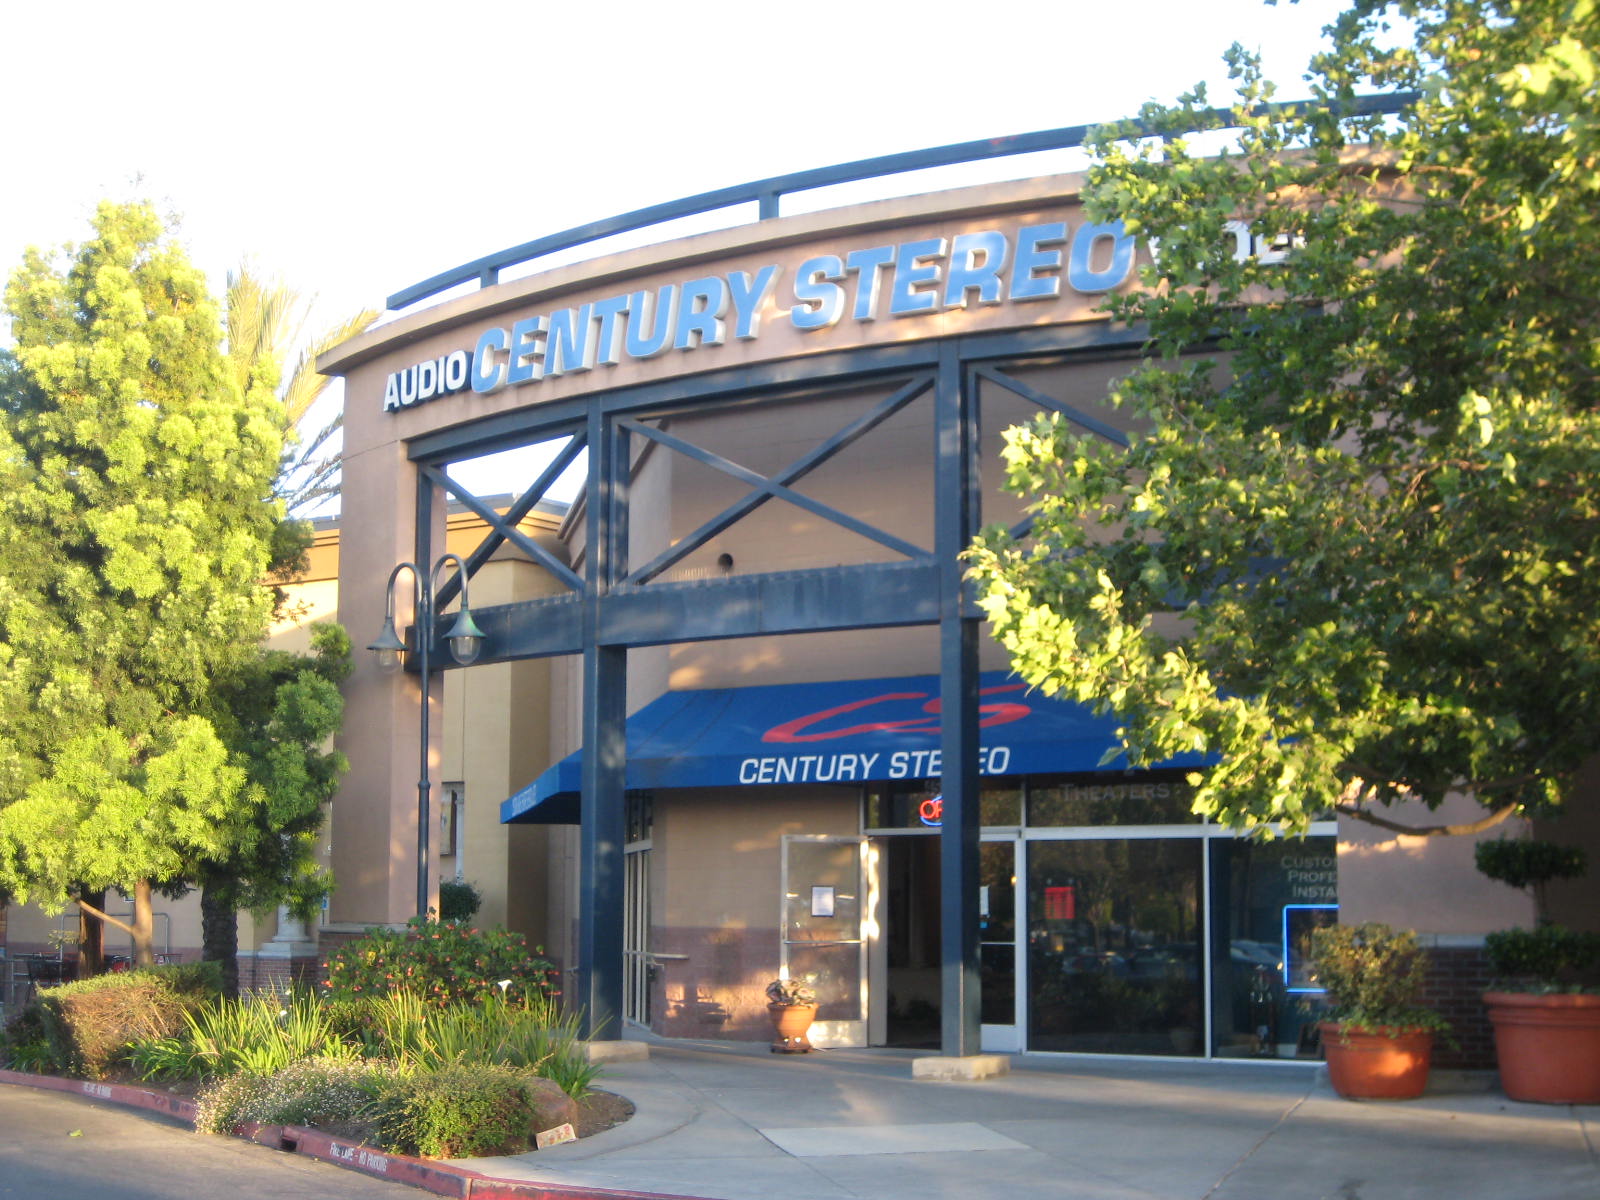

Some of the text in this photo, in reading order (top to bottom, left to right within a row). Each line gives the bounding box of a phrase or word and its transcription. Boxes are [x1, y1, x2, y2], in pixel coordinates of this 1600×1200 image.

[382, 350, 468, 413] AUDIO
[471, 264, 782, 394] CENTURY
[791, 217, 1136, 331] STEREO
[738, 746, 1011, 785] CENTURY STEO
[1060, 782, 1170, 801] THEATERS
[1281, 855, 1338, 869] CUSTO
